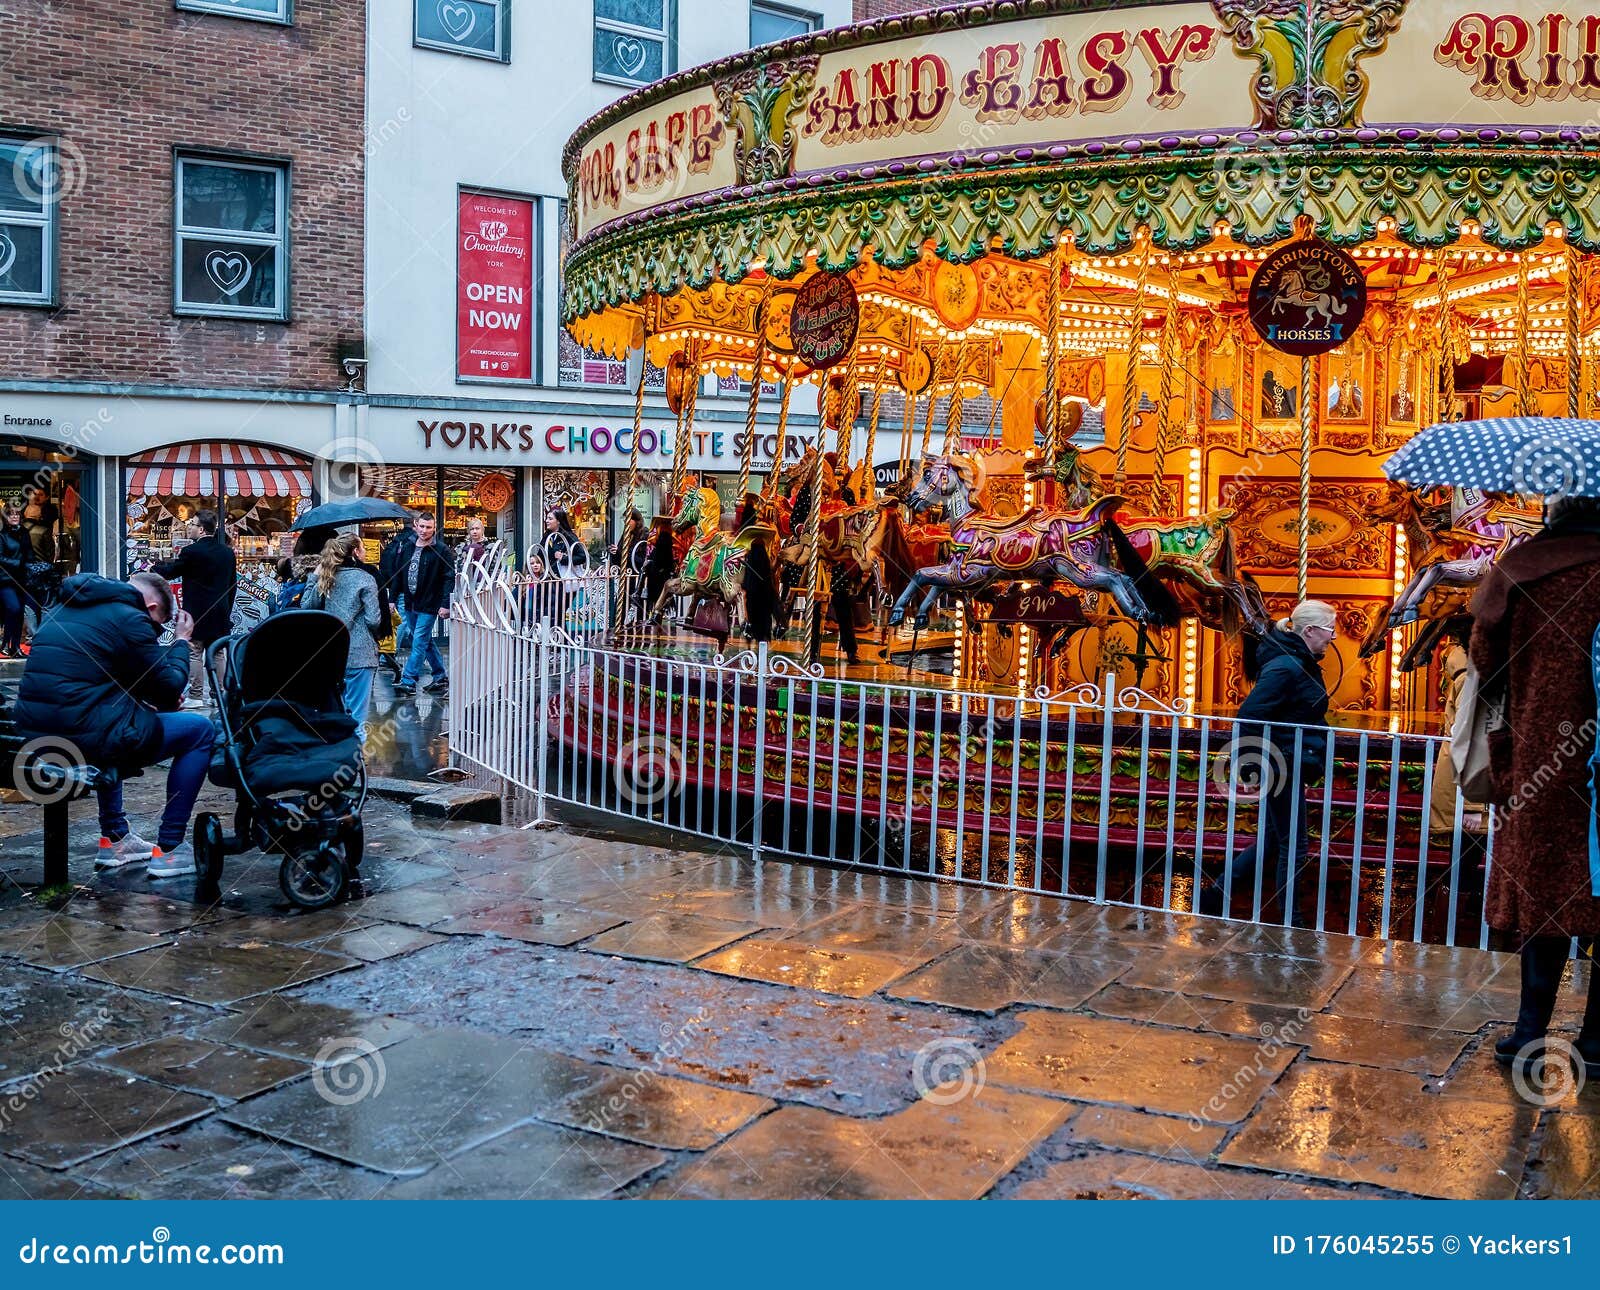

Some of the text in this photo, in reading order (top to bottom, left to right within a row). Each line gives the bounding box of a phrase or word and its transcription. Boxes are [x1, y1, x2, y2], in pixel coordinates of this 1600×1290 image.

[626, 104, 725, 188] SAFE
[806, 53, 951, 136] AND
[963, 24, 1217, 117] EASY
[474, 206, 507, 215] WELCOME
[1258, 248, 1358, 287] WARRINGTON'S
[466, 282, 523, 305] OPEN
[469, 309, 521, 331] NOW
[797, 297, 852, 330] YEARS
[1277, 329, 1331, 341] HORSES
[4, 414, 52, 426] Entrance
[417, 420, 534, 451] YORK'S
